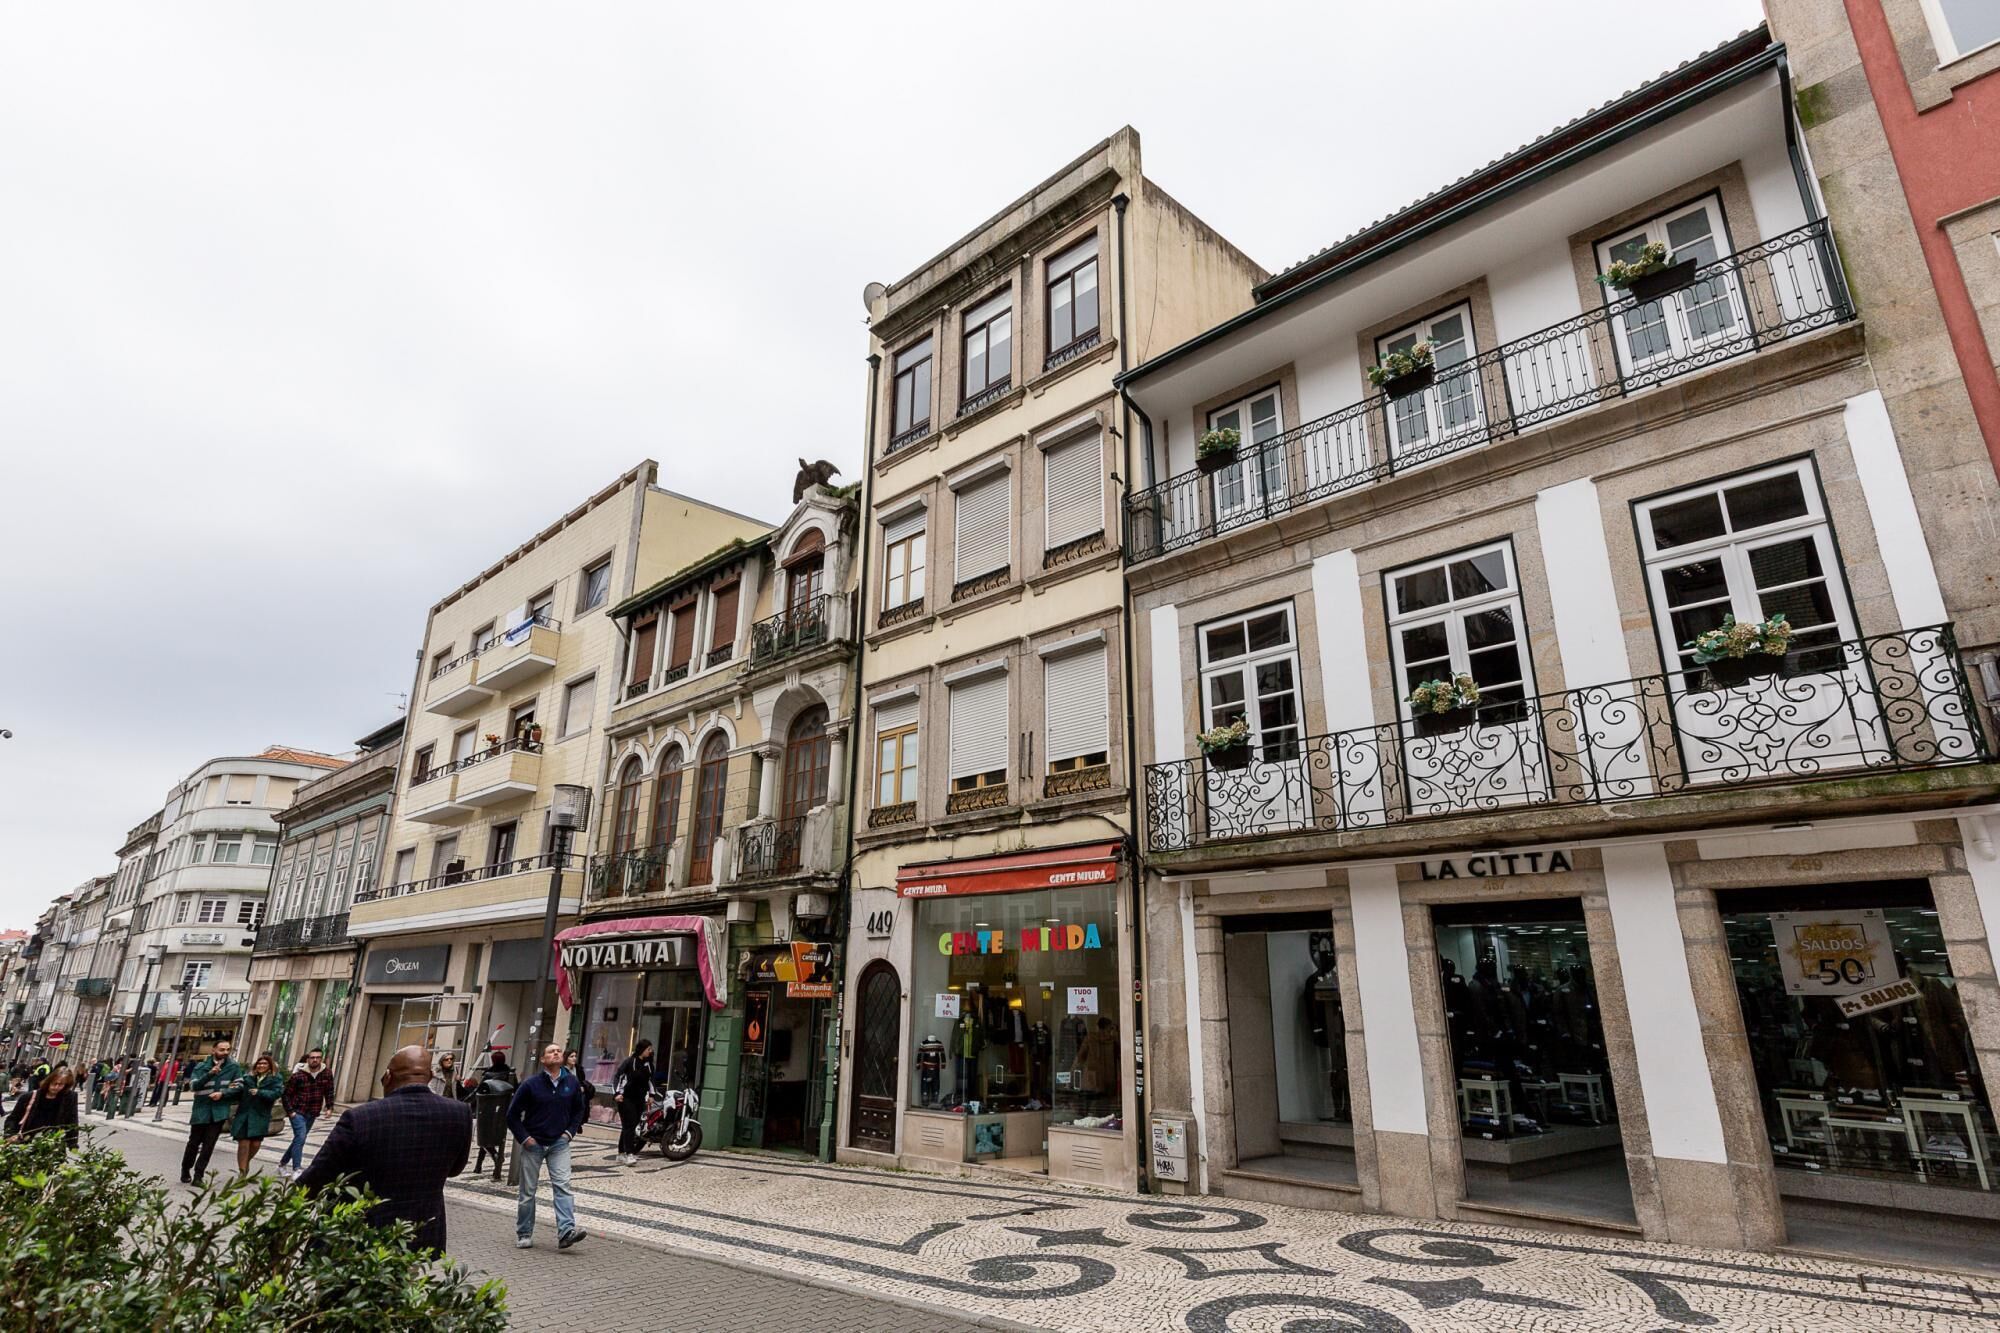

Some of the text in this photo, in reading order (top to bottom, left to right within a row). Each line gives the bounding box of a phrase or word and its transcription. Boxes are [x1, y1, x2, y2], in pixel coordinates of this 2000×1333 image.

[1421, 851, 1571, 881] LA CITTA
[1049, 869, 1106, 884] GENTE MIUDA
[903, 884, 947, 896] GENTE MIUDA
[867, 910, 893, 934] 449
[938, 923, 1101, 956] GENTE MIUDA
[1800, 939, 1865, 951] SALDOS
[559, 941, 670, 967] NOVALMA
[385, 957, 420, 974] ORIGEM
[794, 983, 800, 991] A
[1861, 982, 1917, 1007] SALDOS
